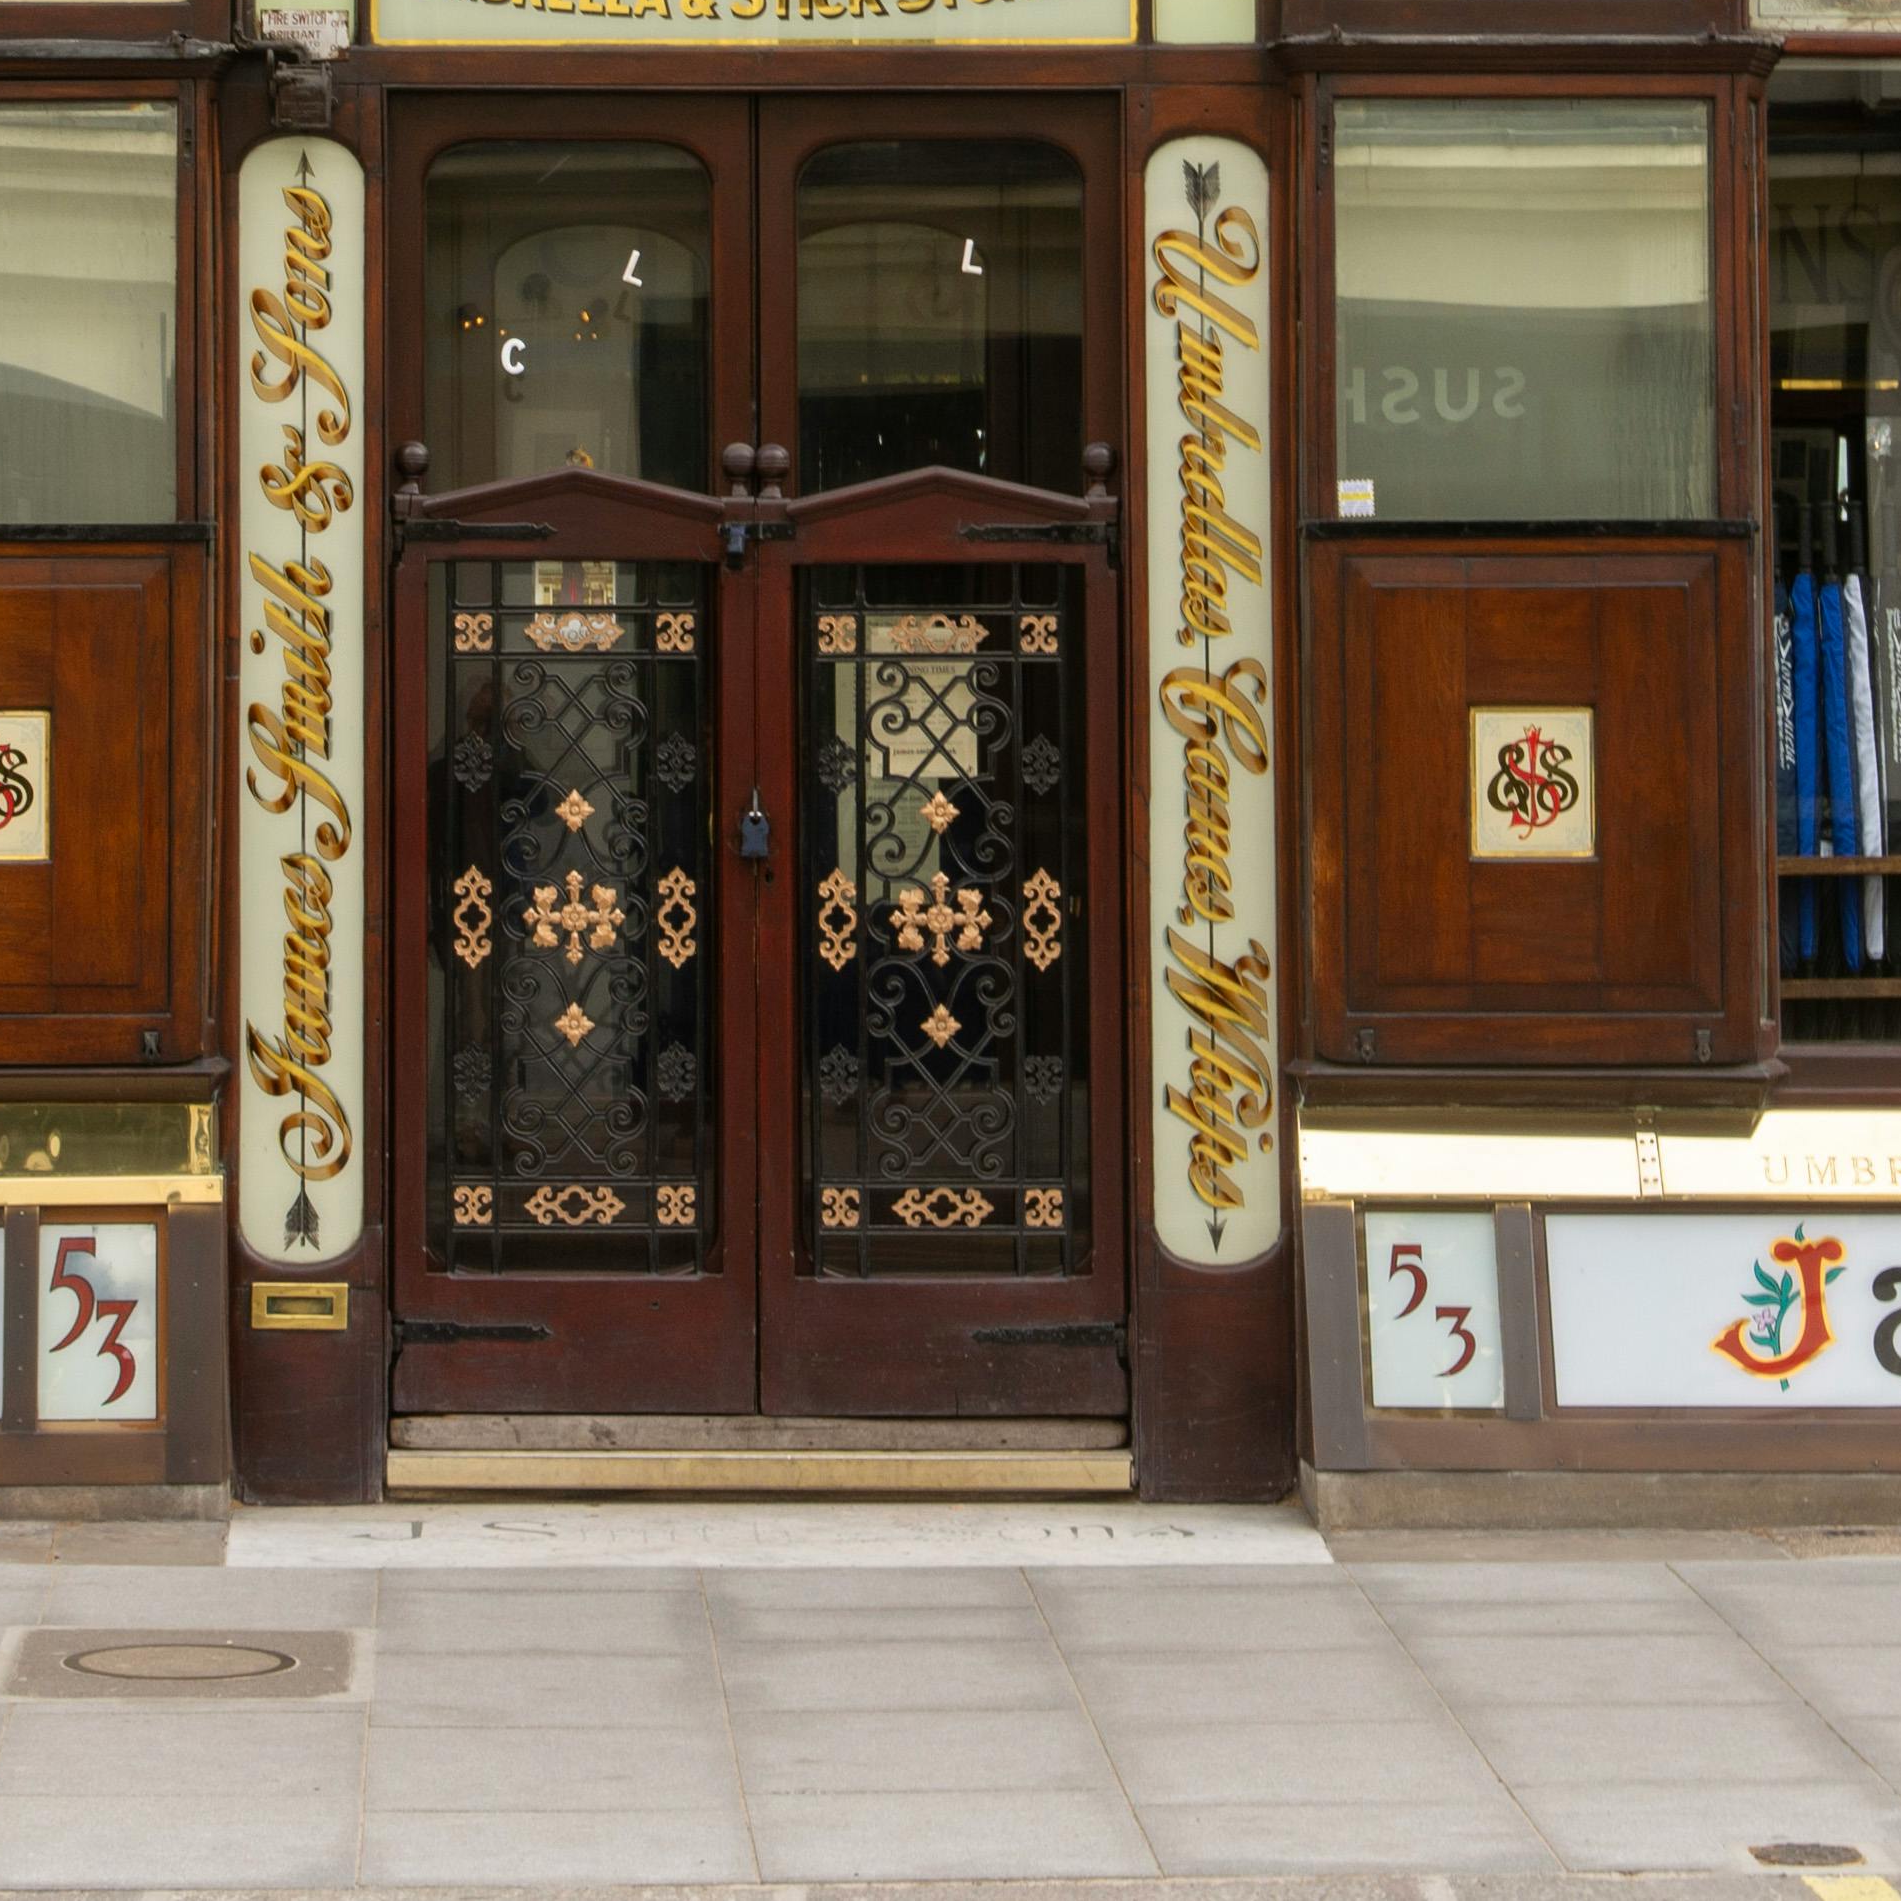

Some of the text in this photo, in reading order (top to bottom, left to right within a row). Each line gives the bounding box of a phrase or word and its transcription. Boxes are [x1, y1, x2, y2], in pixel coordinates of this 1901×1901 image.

[250, 183, 349, 445] Sons
[501, 337, 526, 375] C
[259, 423, 355, 531] &
[246, 550, 351, 858] Smith
[244, 853, 353, 1179] James
[1163, 925, 1274, 1211] Whips
[48, 1236, 136, 1407] 53
[1387, 1244, 1476, 1379] 53
